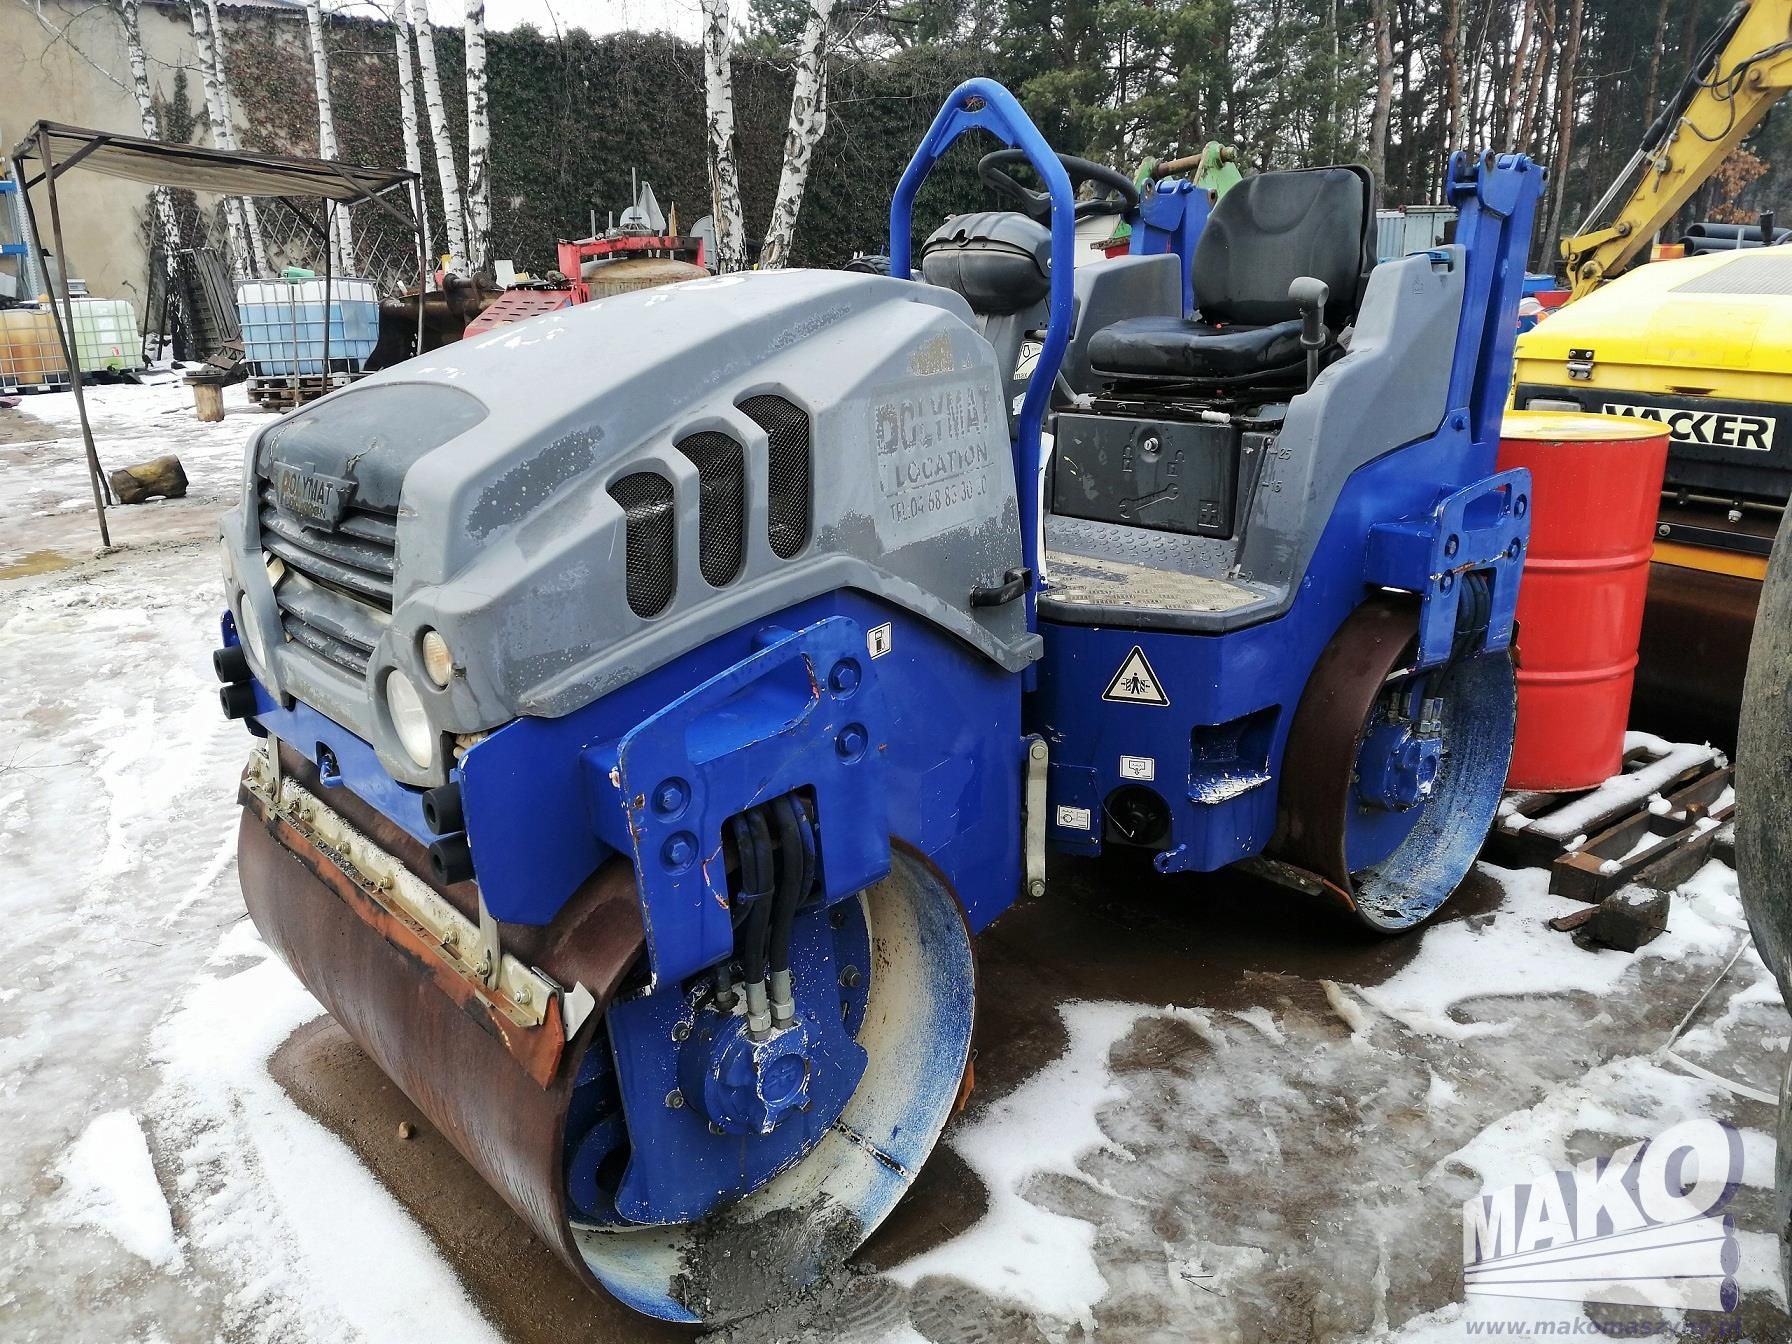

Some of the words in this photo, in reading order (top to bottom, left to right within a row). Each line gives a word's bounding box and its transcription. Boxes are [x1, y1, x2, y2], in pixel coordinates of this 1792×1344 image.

[1605, 405, 1769, 449] CKER
[896, 441, 988, 489] LOCATION
[928, 488, 942, 512] 68
